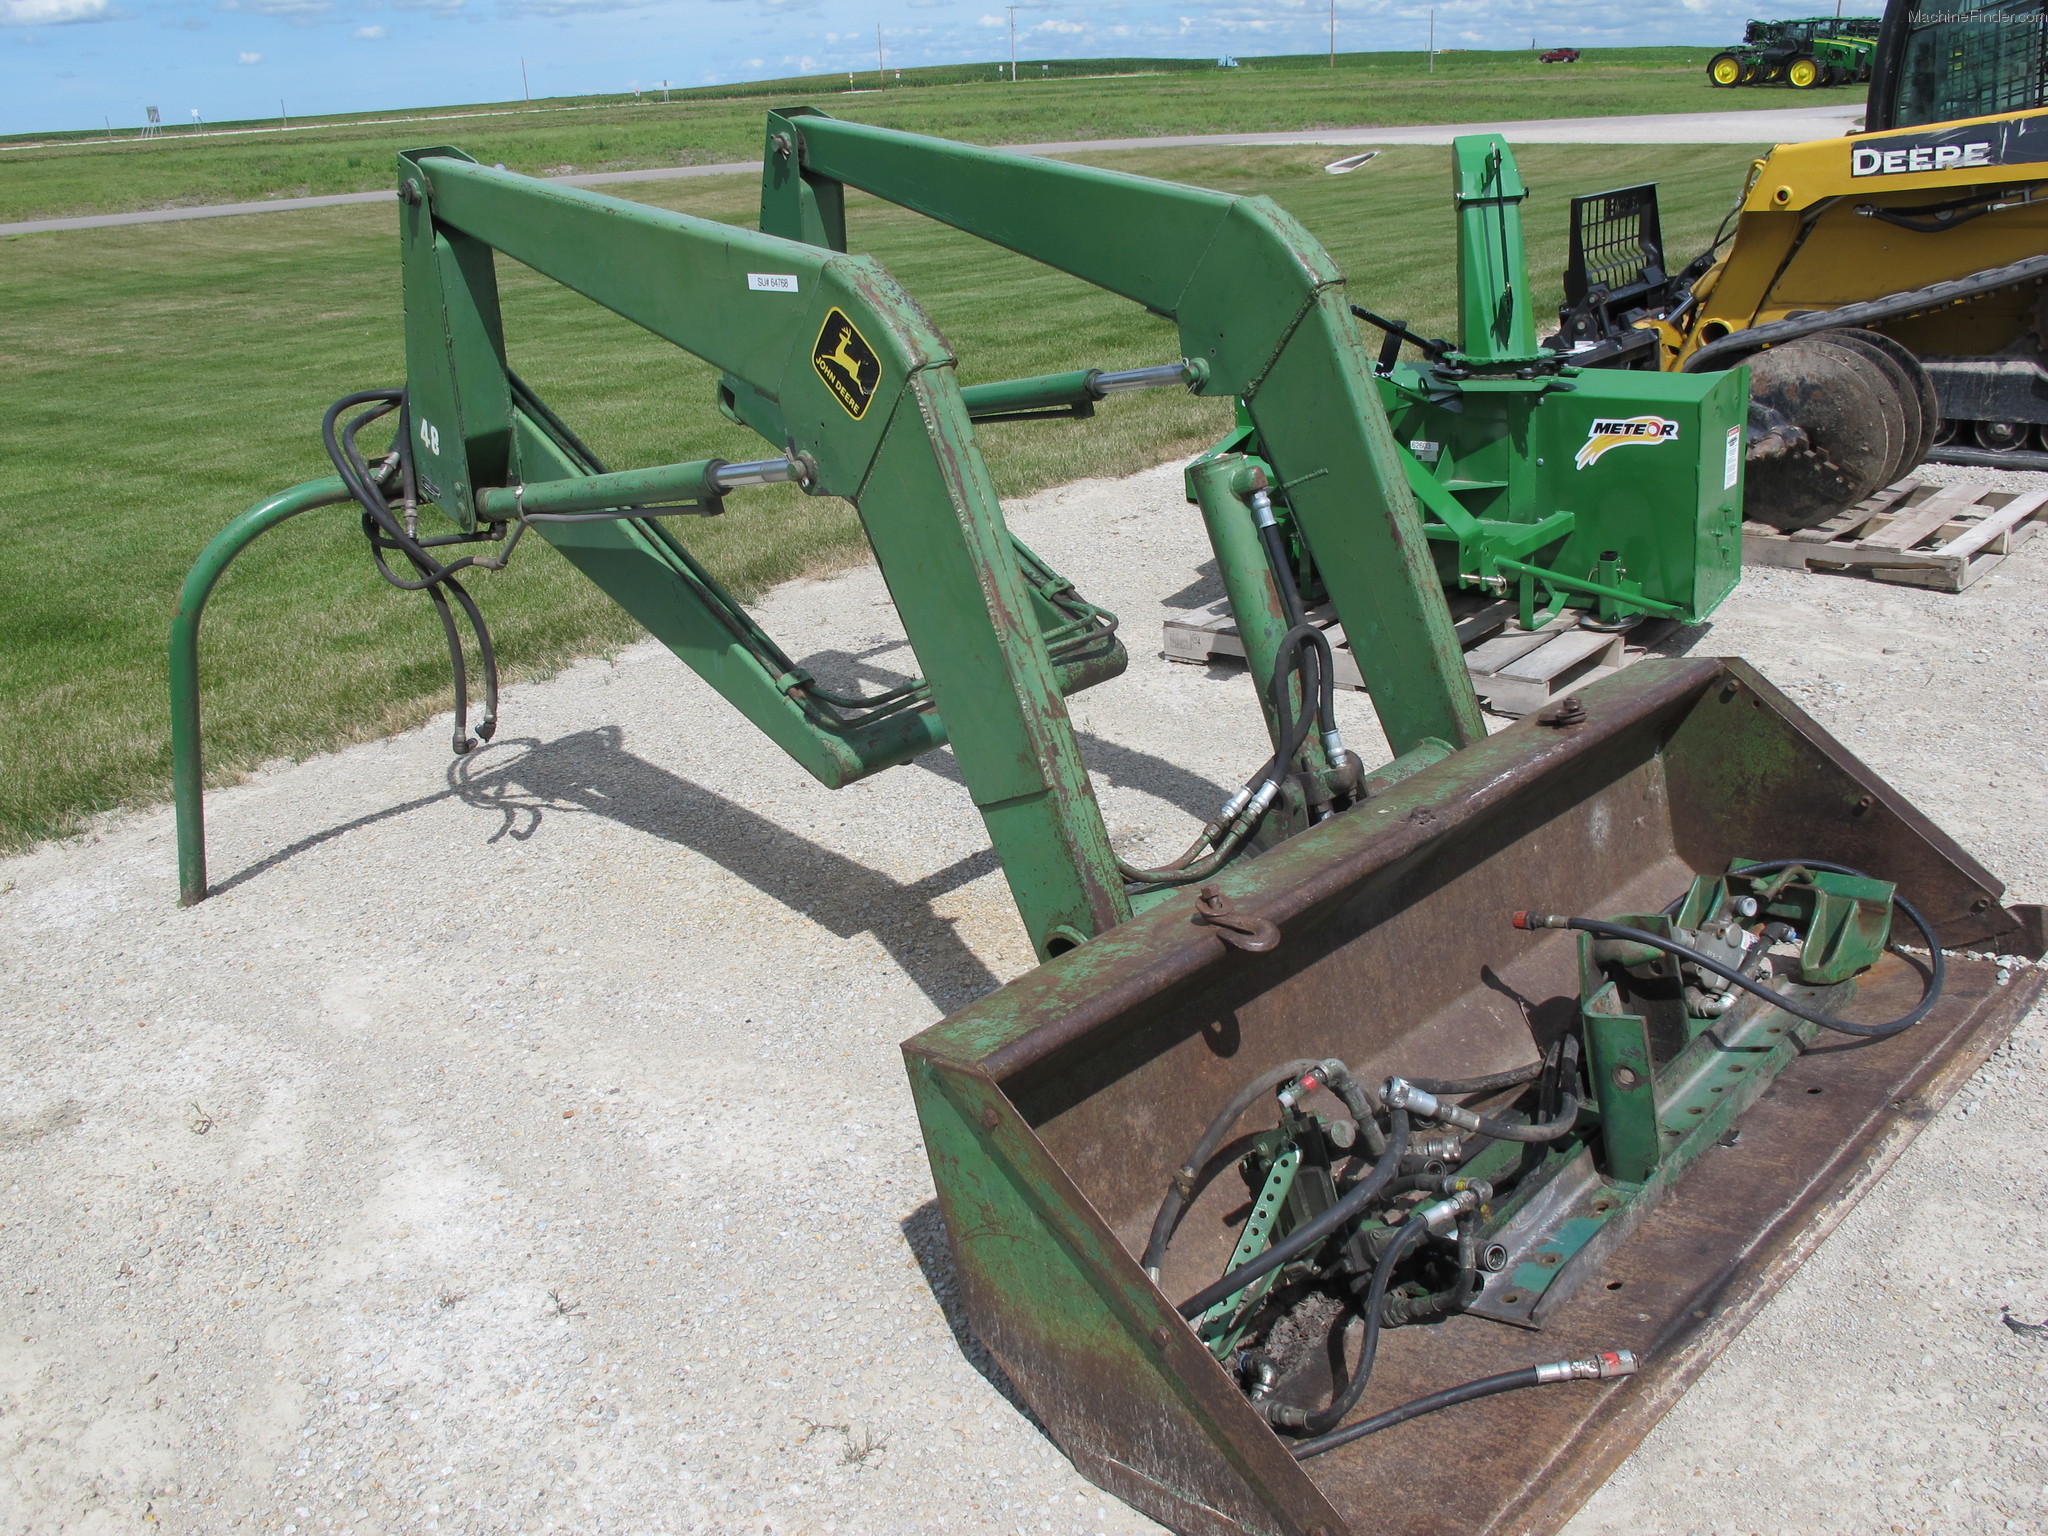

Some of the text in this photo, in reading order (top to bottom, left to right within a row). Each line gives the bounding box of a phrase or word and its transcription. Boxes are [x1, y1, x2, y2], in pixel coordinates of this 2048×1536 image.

[1853, 142, 1989, 176] DEERE
[757, 277, 770, 287] SU#
[815, 356, 860, 414] JOHN DEERE
[420, 418, 440, 456] 48
[1593, 421, 1675, 437] METEOR
